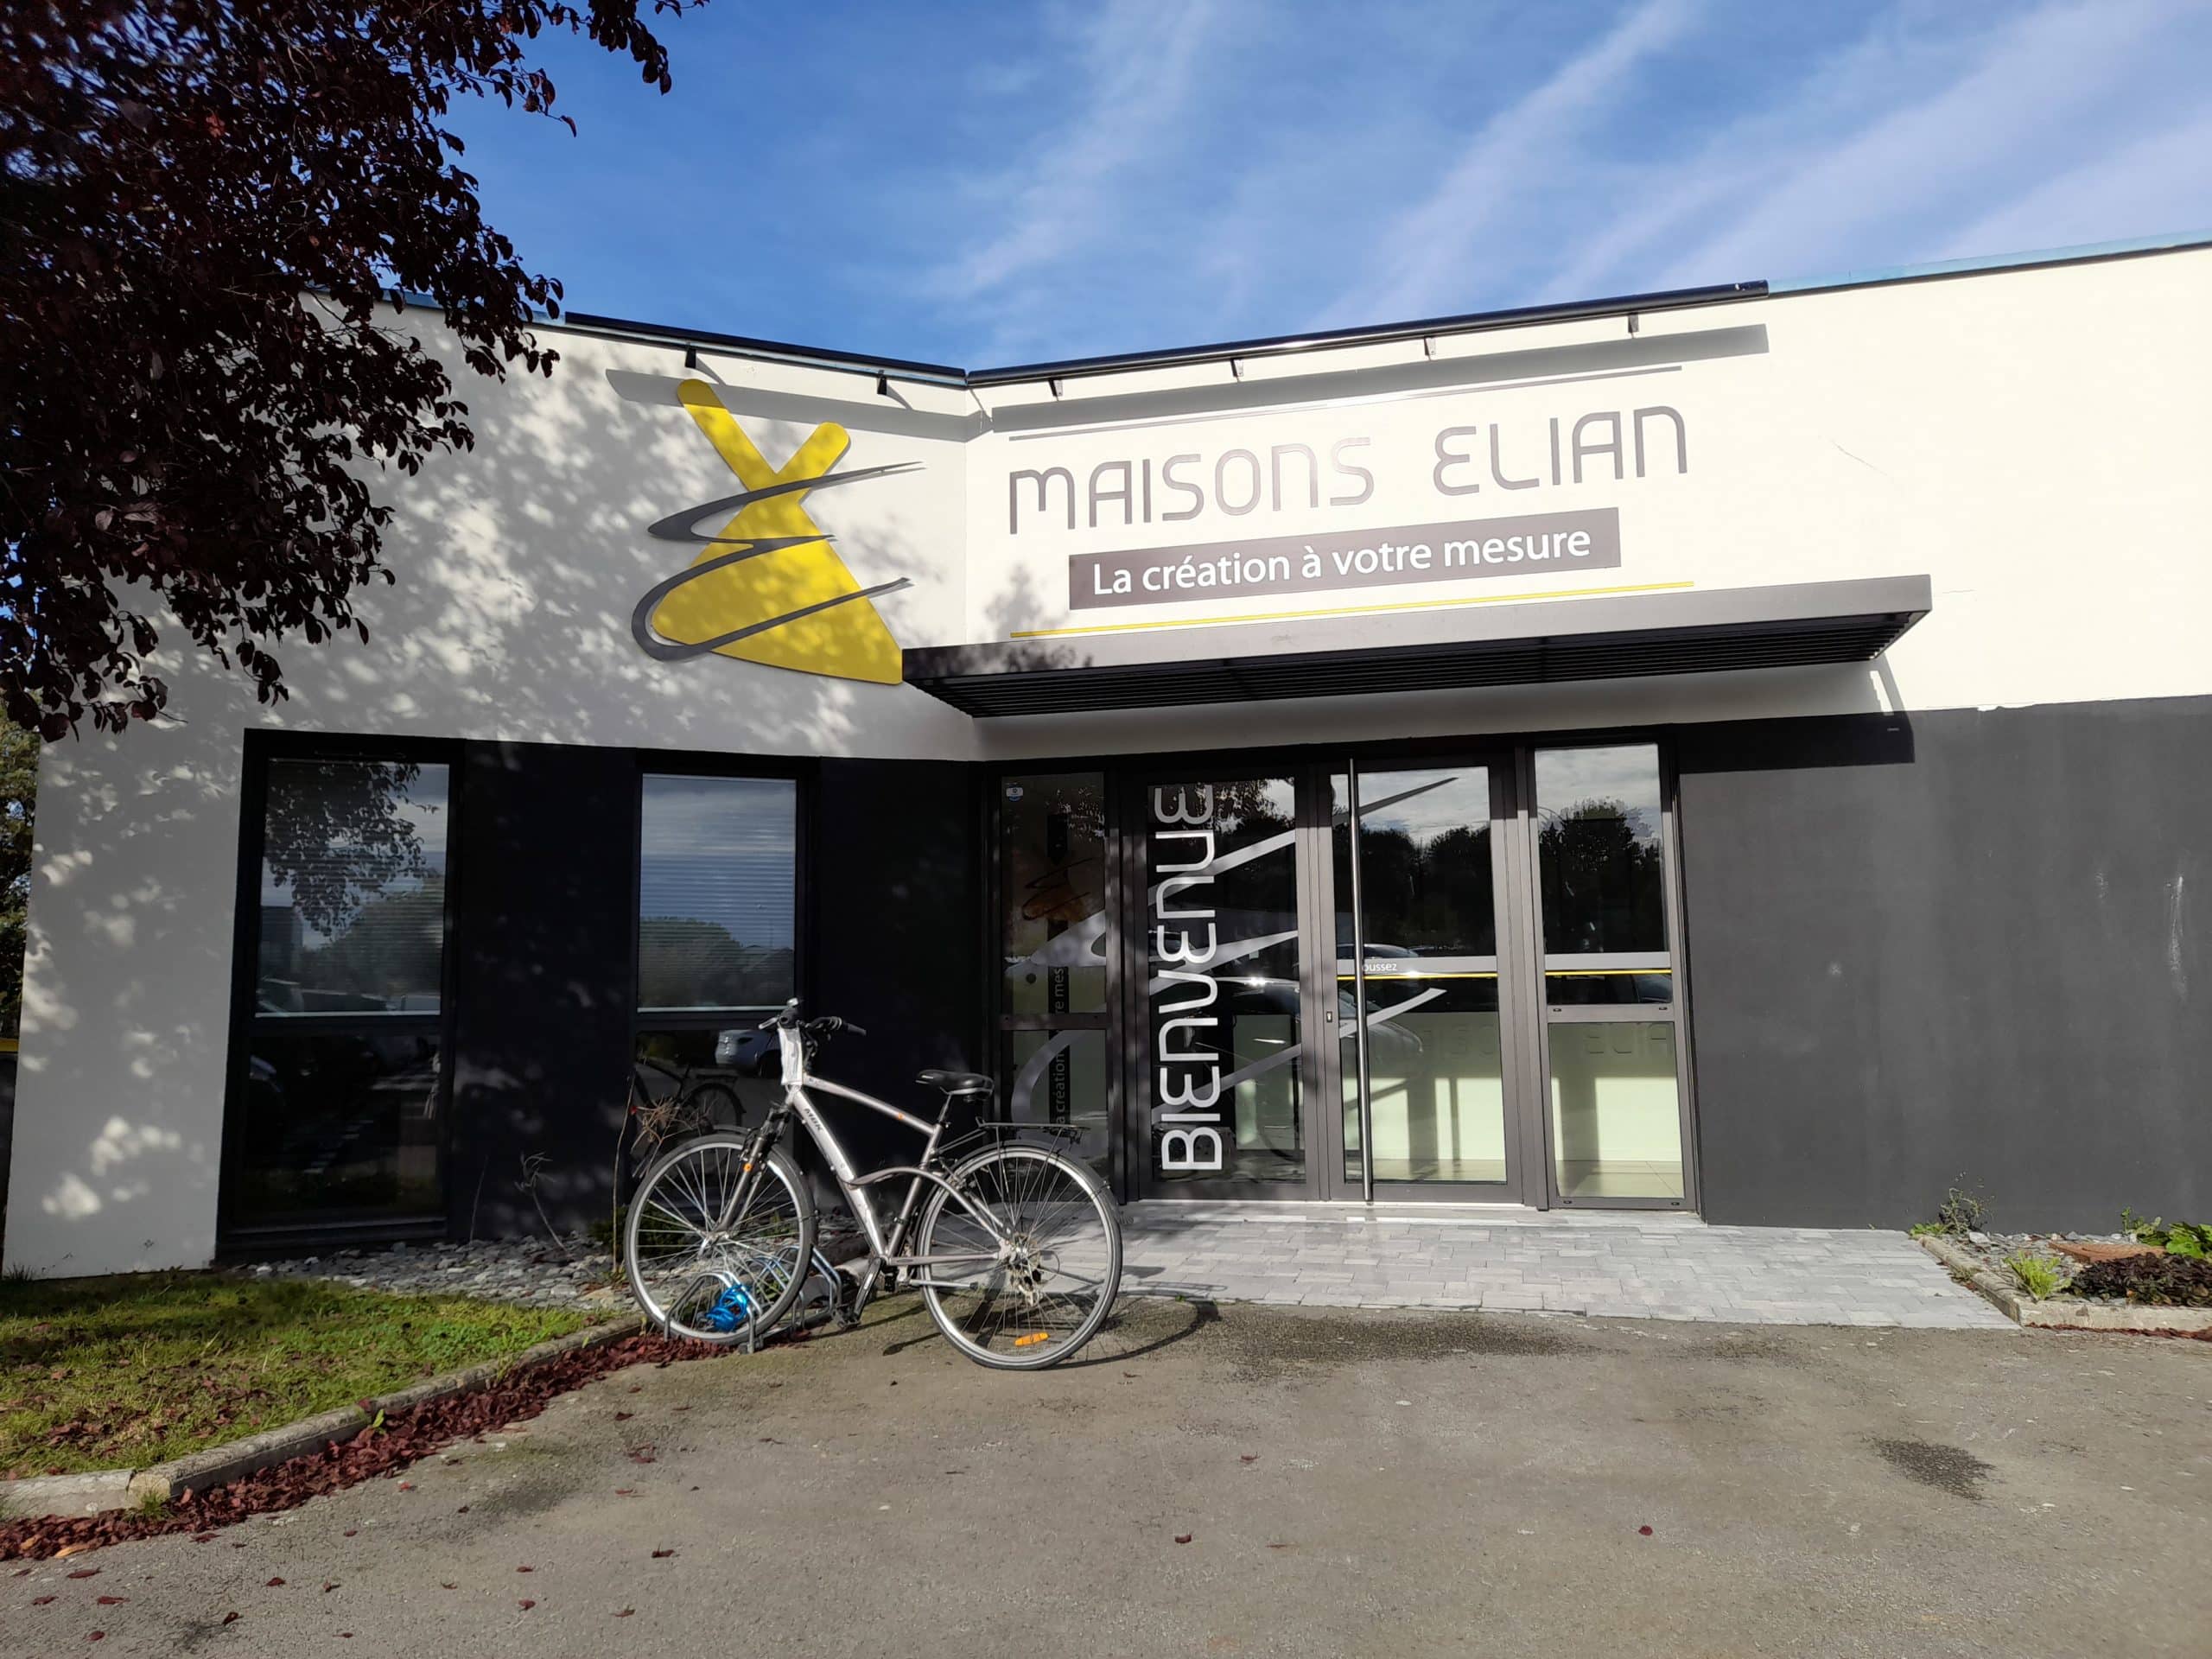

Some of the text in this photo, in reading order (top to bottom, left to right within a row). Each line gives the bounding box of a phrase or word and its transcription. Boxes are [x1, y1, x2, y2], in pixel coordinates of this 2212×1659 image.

[1008, 405, 1688, 536] MAISONS ELIAN
[1093, 531, 1591, 595] La création à votre mesure
[1054, 967, 1065, 998] mes
[1154, 785, 1223, 1170] BIENVENUE
[1362, 962, 1397, 973] oussez
